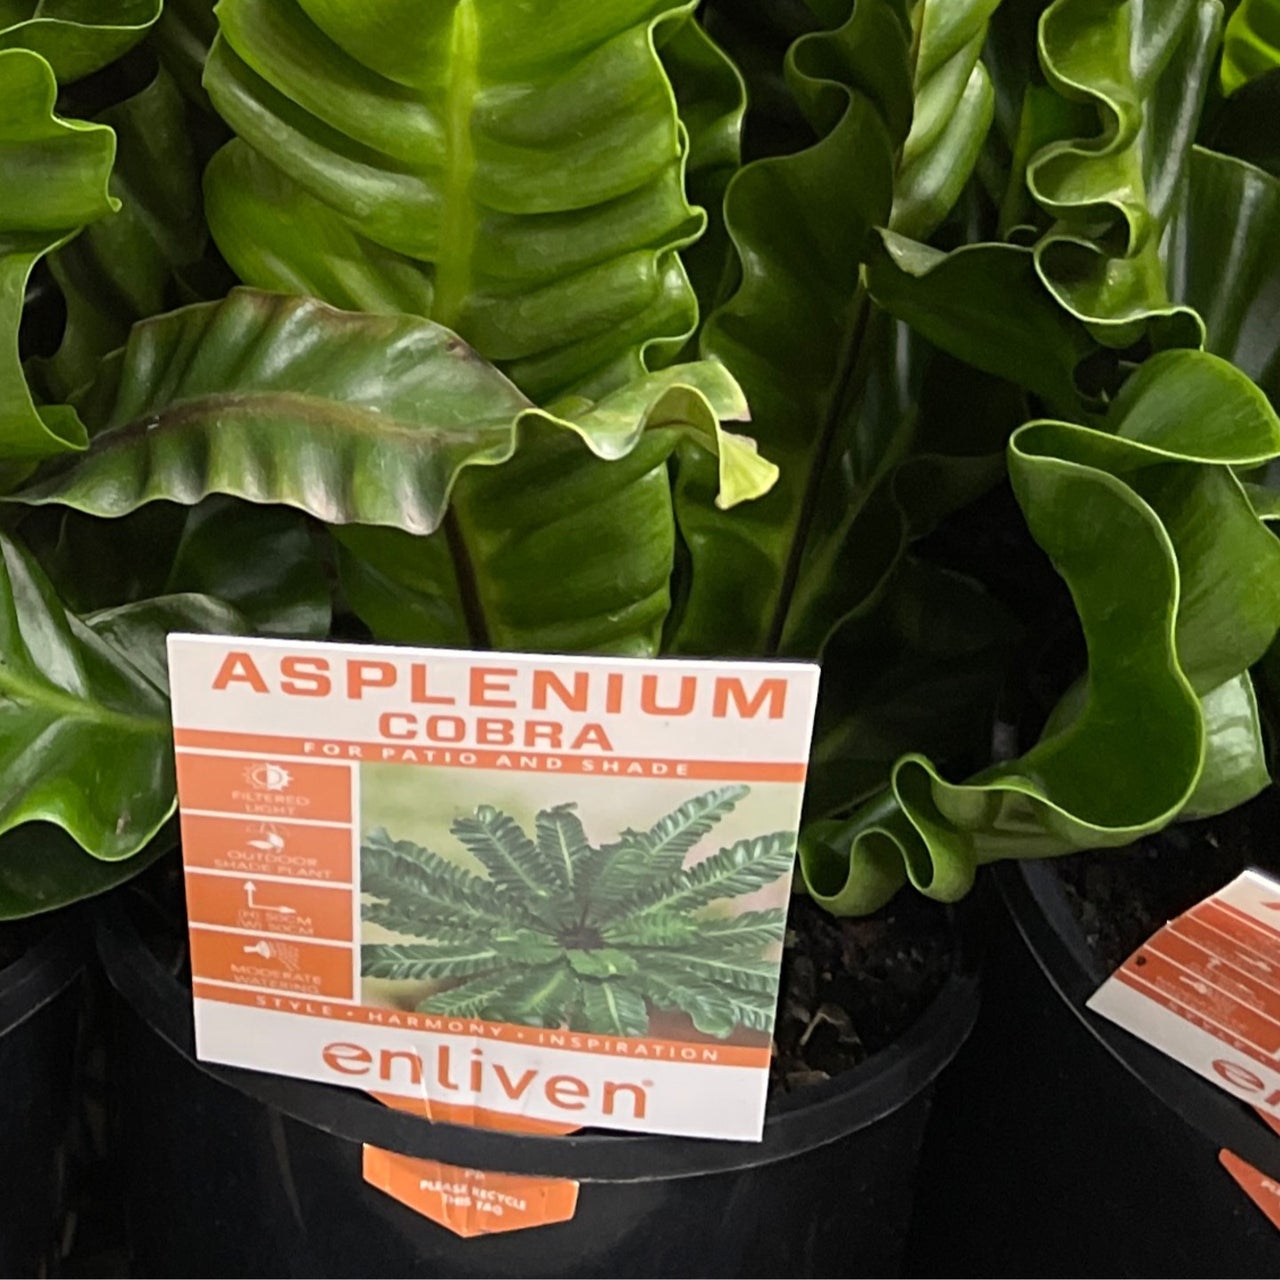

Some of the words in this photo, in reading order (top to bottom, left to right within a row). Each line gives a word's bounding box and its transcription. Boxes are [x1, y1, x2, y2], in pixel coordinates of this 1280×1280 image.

[211, 651, 788, 719] ASPLENIUM
[378, 712, 613, 752] COBRA
[303, 741, 363, 758] FOR
[381, 748, 477, 765] PATIO
[495, 754, 563, 769] AND
[581, 759, 688, 776] SHADE
[231, 790, 310, 806] FILTERED
[227, 849, 318, 867] OUTDOOR
[230, 963, 322, 985] MODERATE
[256, 994, 332, 1016] STYLE
[368, 1011, 503, 1037] HARMONY
[538, 1033, 718, 1062] INSPIRATION
[322, 1042, 647, 1119] enliven
[419, 1179, 467, 1195] PLEASE
[471, 1186, 527, 1211] RECYCLE
[442, 1193, 472, 1207] THIS
[475, 1200, 504, 1216] TAG
